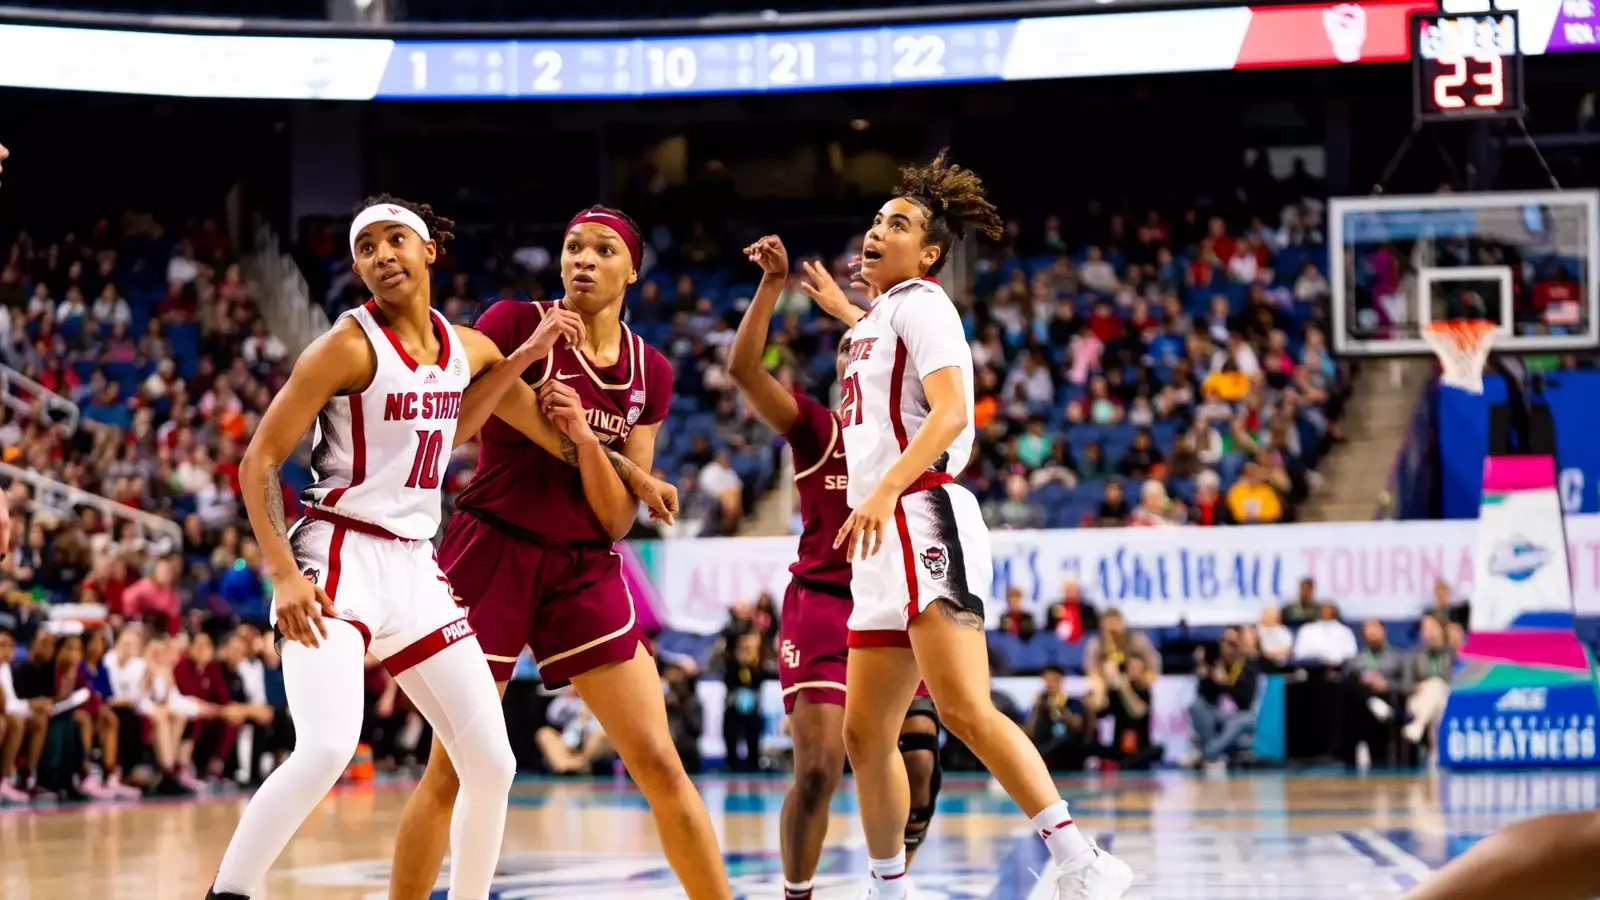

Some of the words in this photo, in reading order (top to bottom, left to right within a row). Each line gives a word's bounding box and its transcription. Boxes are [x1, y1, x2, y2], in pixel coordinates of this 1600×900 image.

[409, 51, 427, 90] 1
[532, 50, 563, 91] 2
[645, 47, 697, 88] 10
[769, 41, 815, 84] 21
[893, 35, 946, 77] 22
[1434, 54, 1504, 108] 23
[384, 391, 418, 421] NC
[421, 391, 462, 420] STATE
[841, 371, 863, 429] 21
[404, 429, 443, 489] 10
[824, 475, 848, 490] SE
[781, 639, 801, 669] FSU
[1447, 727, 1596, 761] GREATNESS
